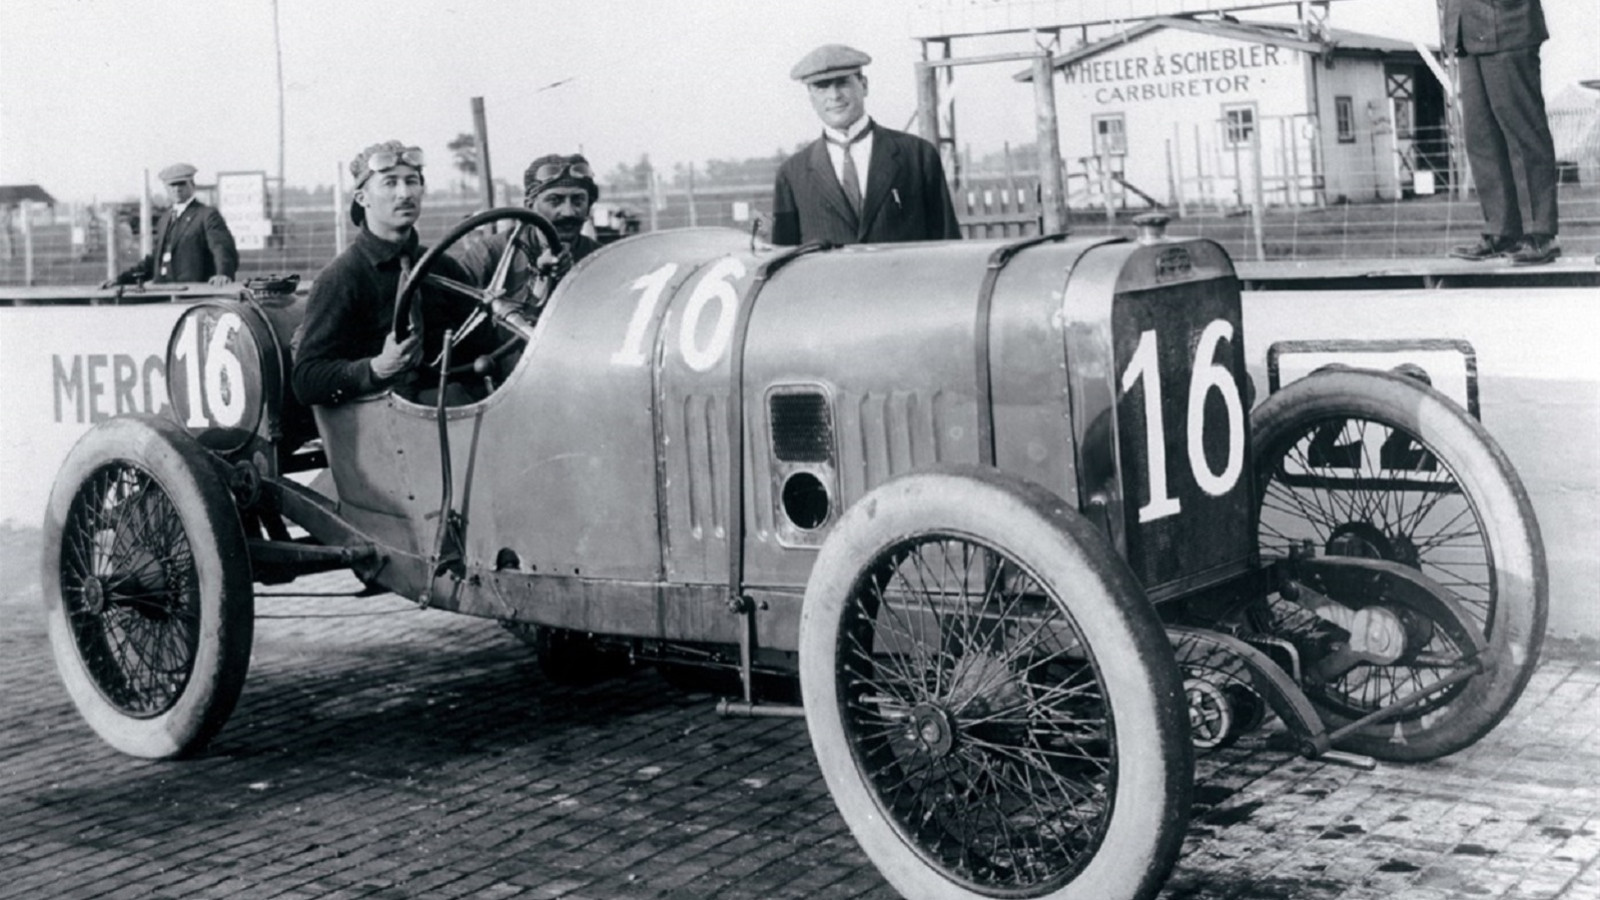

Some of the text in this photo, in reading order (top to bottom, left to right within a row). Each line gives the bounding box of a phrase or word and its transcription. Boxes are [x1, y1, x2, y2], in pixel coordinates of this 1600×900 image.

[1063, 56, 1149, 84] WHEELER
[1153, 54, 1167, 77] &
[1095, 74, 1250, 104] CARBURETOR
[175, 312, 246, 428] 16
[611, 257, 746, 372] 16
[1121, 318, 1246, 523] 16
